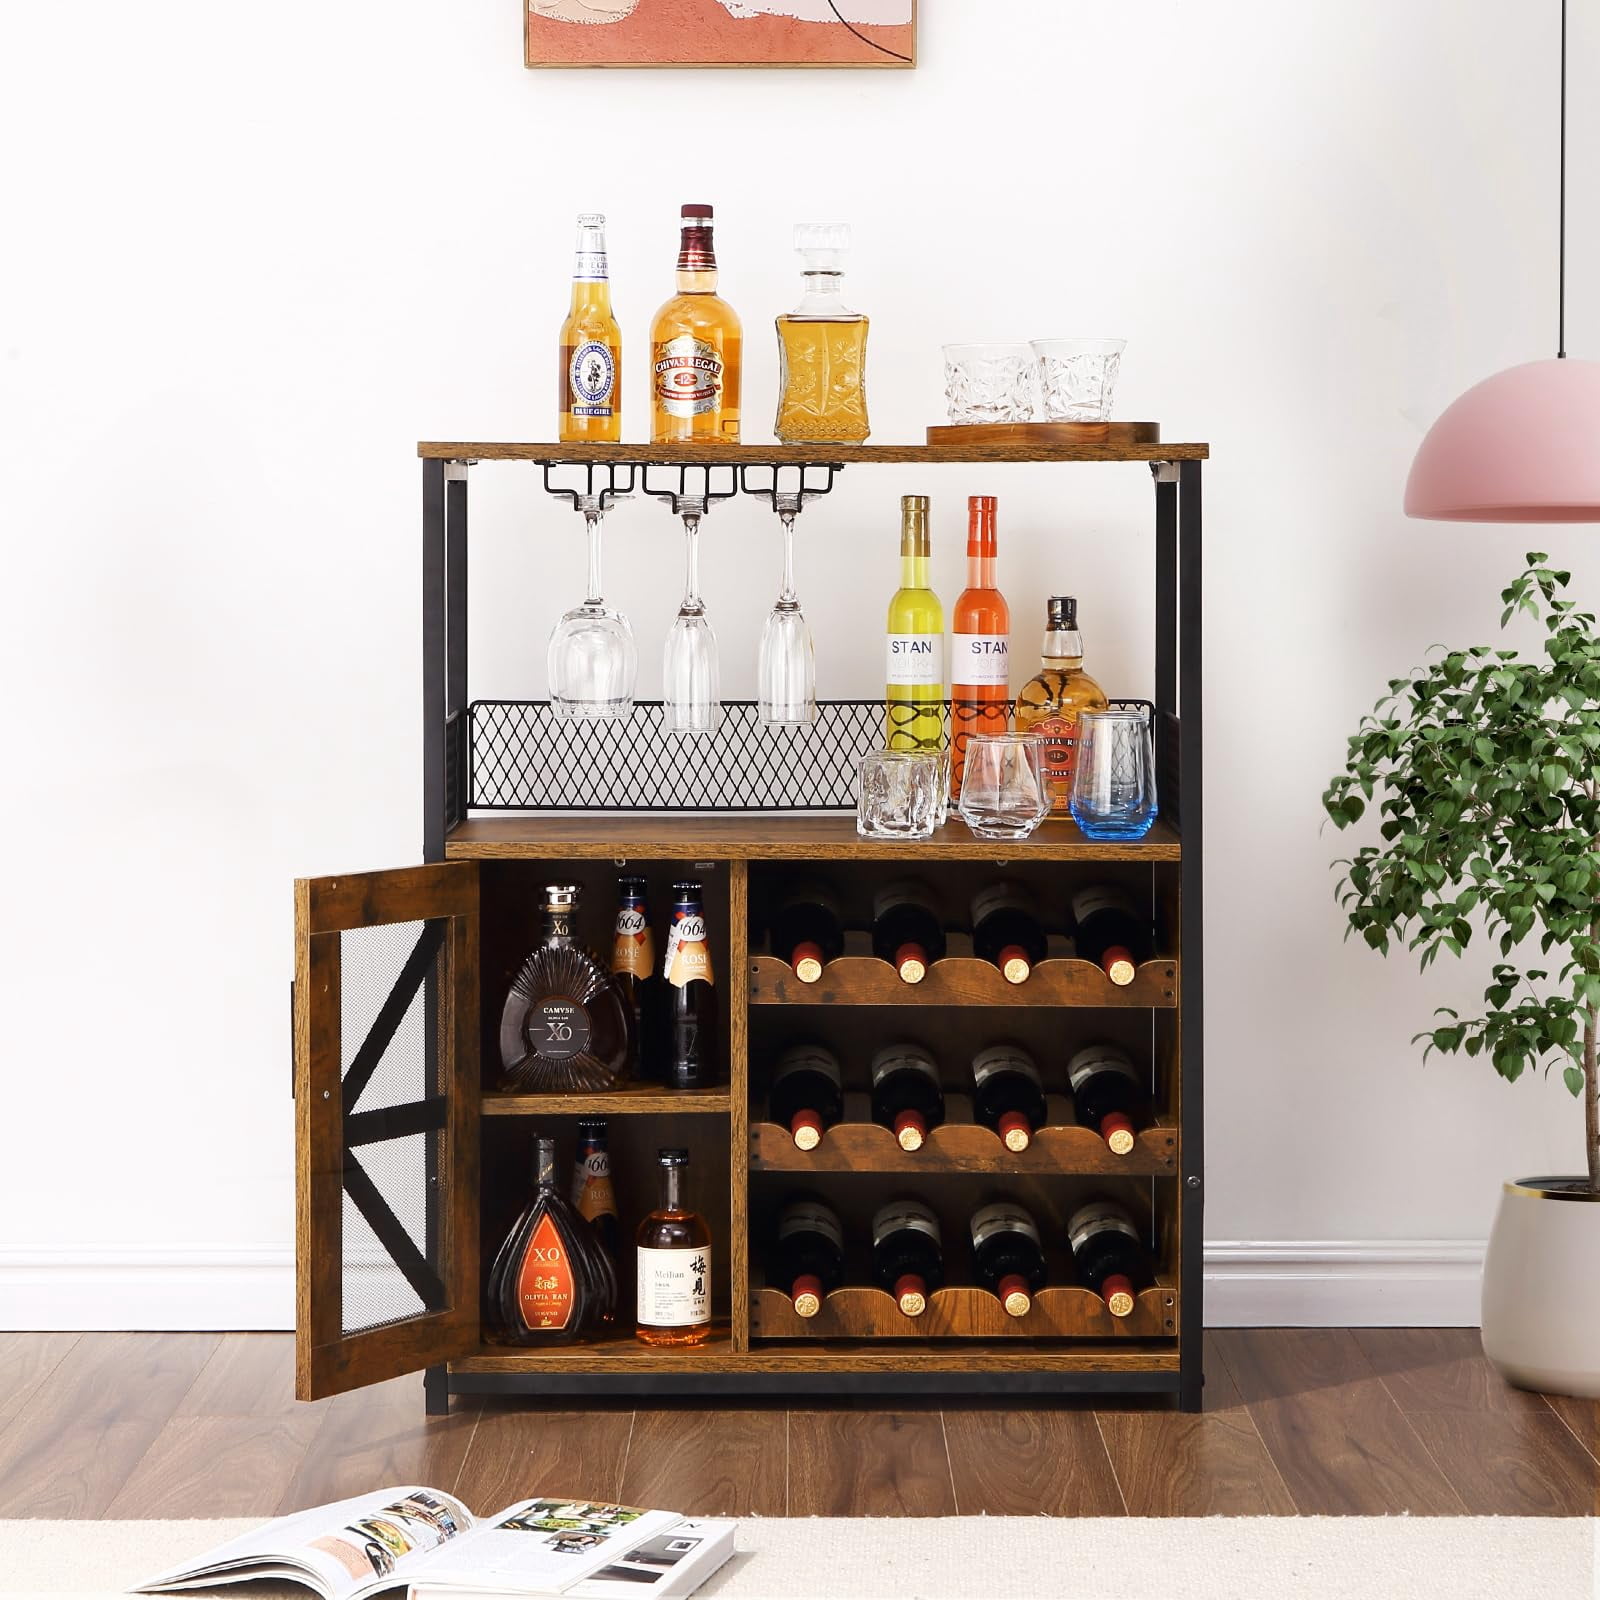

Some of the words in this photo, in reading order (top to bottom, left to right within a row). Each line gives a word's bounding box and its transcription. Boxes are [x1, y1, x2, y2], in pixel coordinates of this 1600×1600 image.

[655, 358, 685, 373] CHIVAS
[687, 358, 720, 374] REGAL
[680, 374, 691, 385] 12
[575, 407, 594, 415] BLUE
[891, 640, 932, 654] STAN
[971, 641, 1008, 655] STAN
[552, 920, 569, 936] XO
[546, 1022, 573, 1041] XO
[586, 1156, 608, 1172] 166
[534, 1247, 560, 1262] XO
